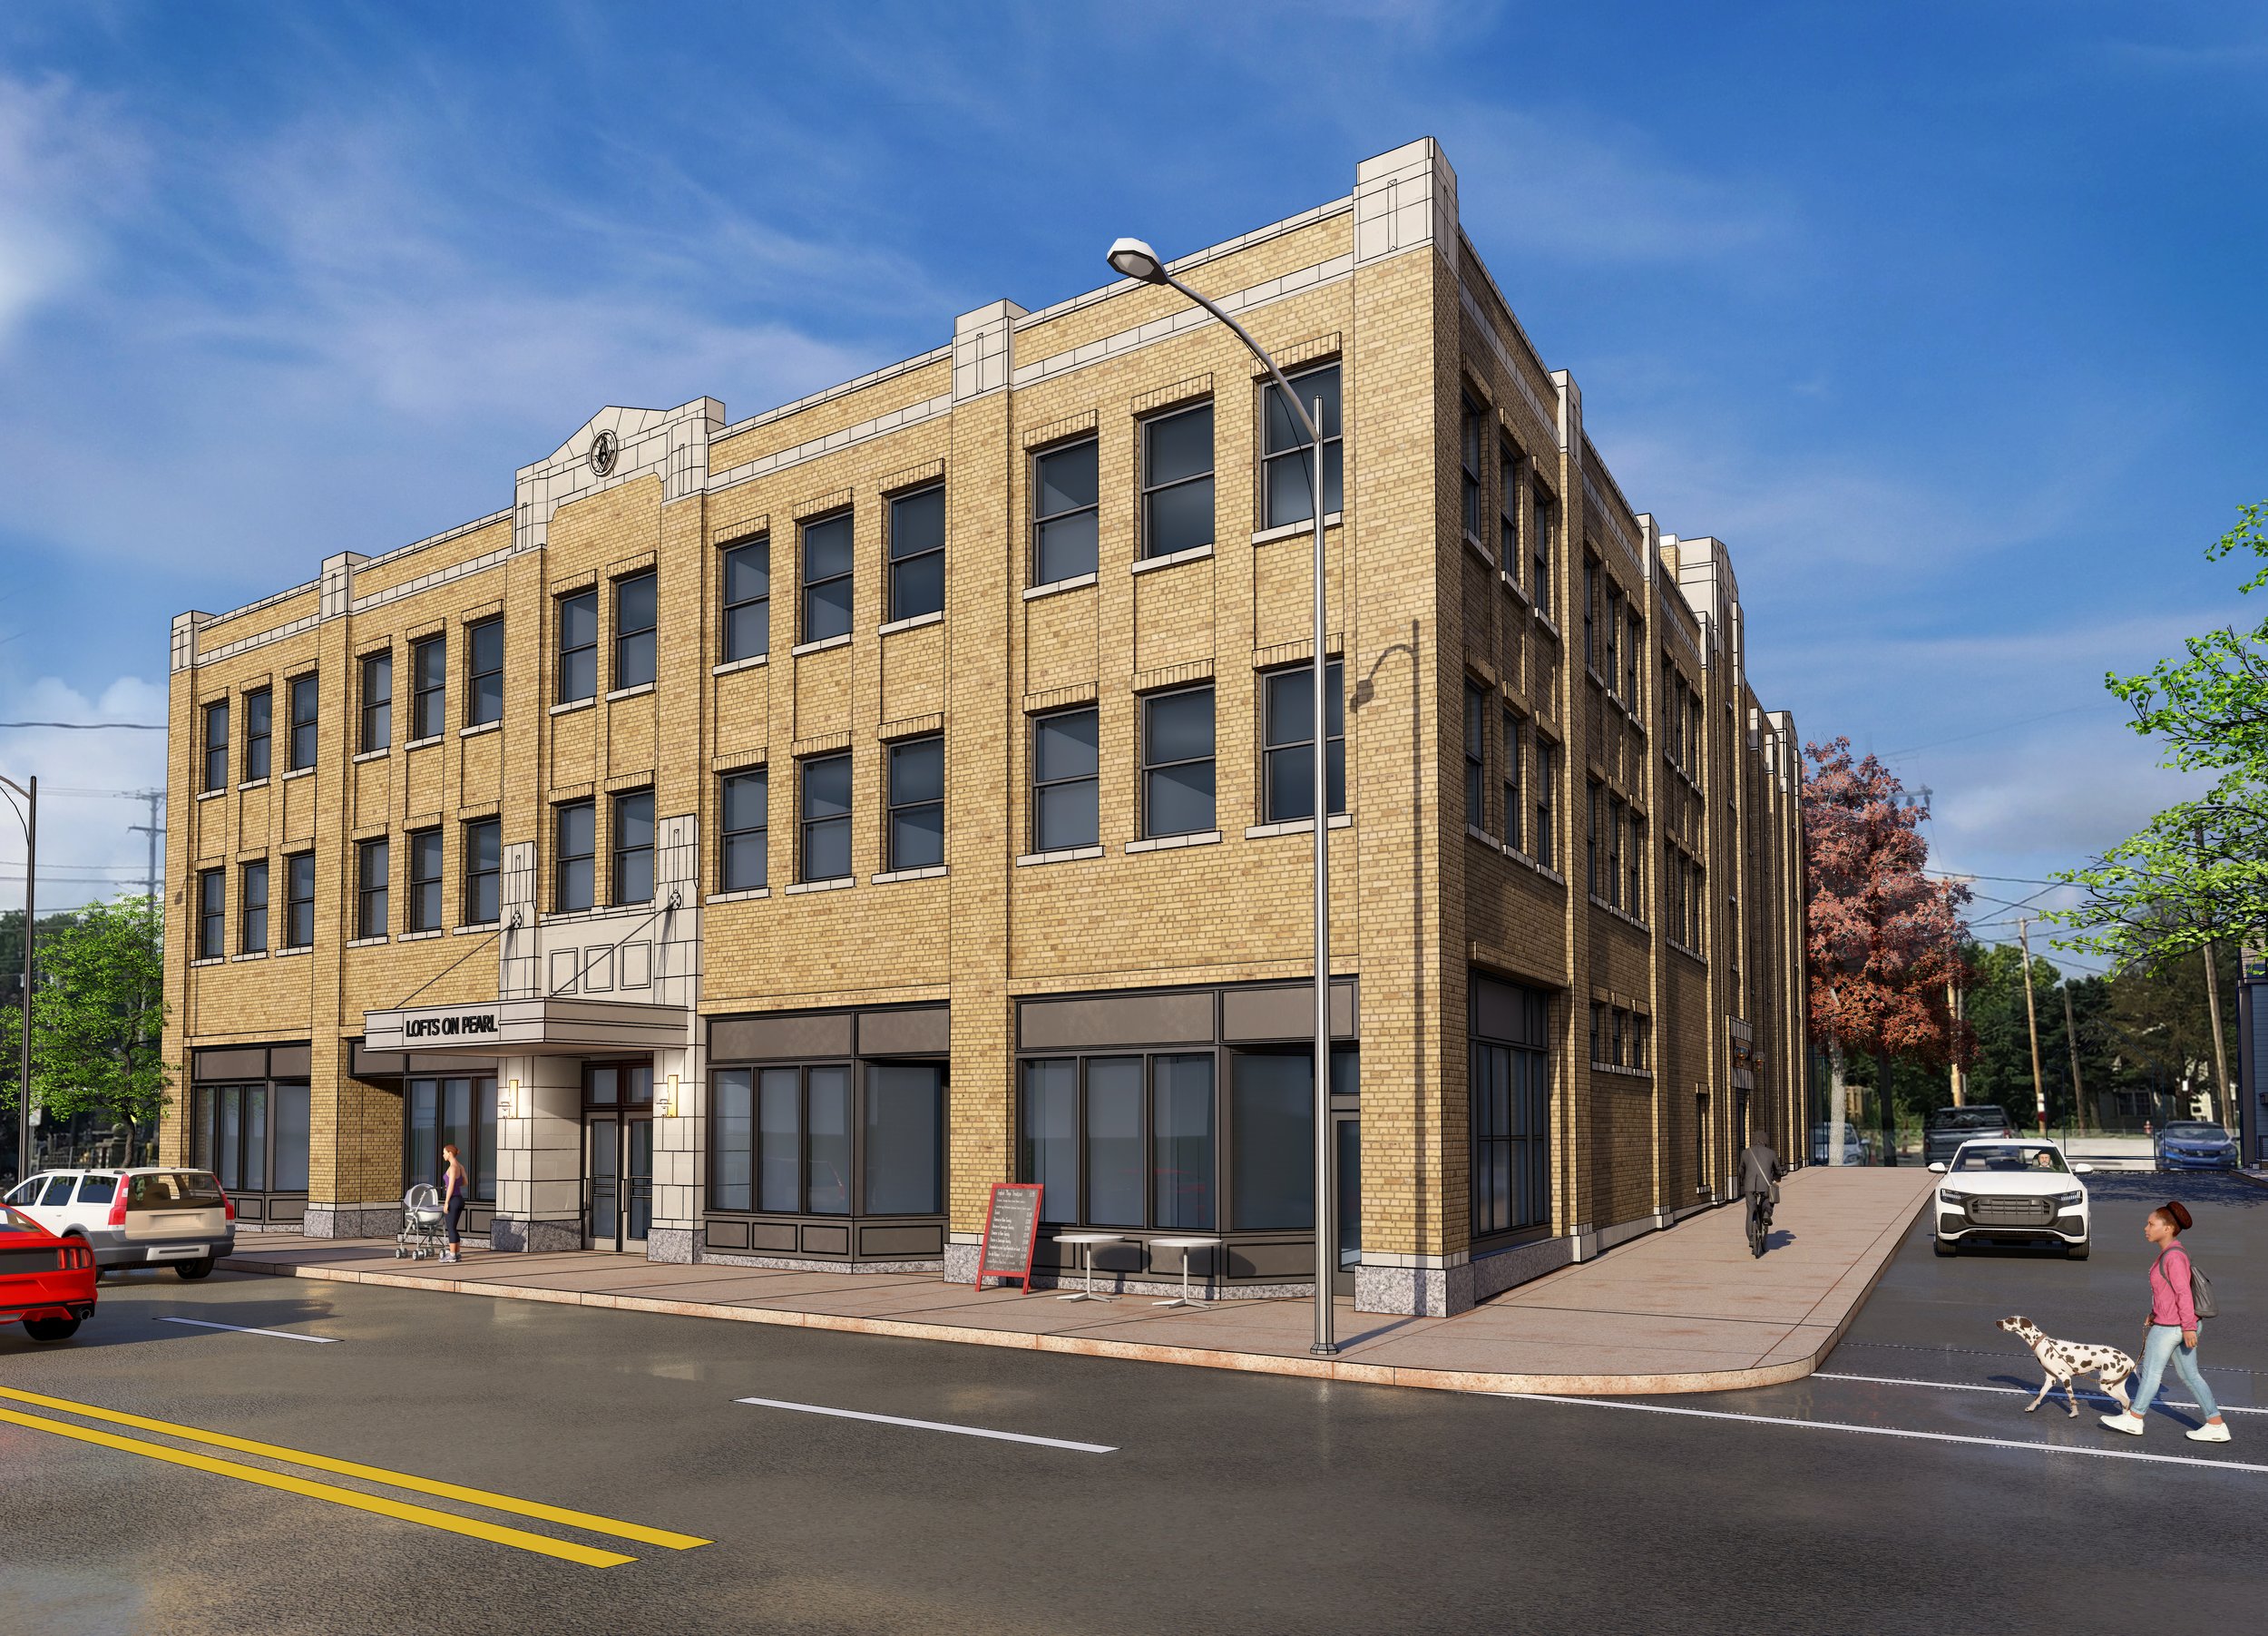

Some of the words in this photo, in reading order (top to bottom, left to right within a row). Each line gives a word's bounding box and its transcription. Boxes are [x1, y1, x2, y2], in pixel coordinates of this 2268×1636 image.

[406, 1018, 440, 1037] LOFTS
[442, 1017, 460, 1035] ON
[462, 1014, 498, 1034] PEARL
